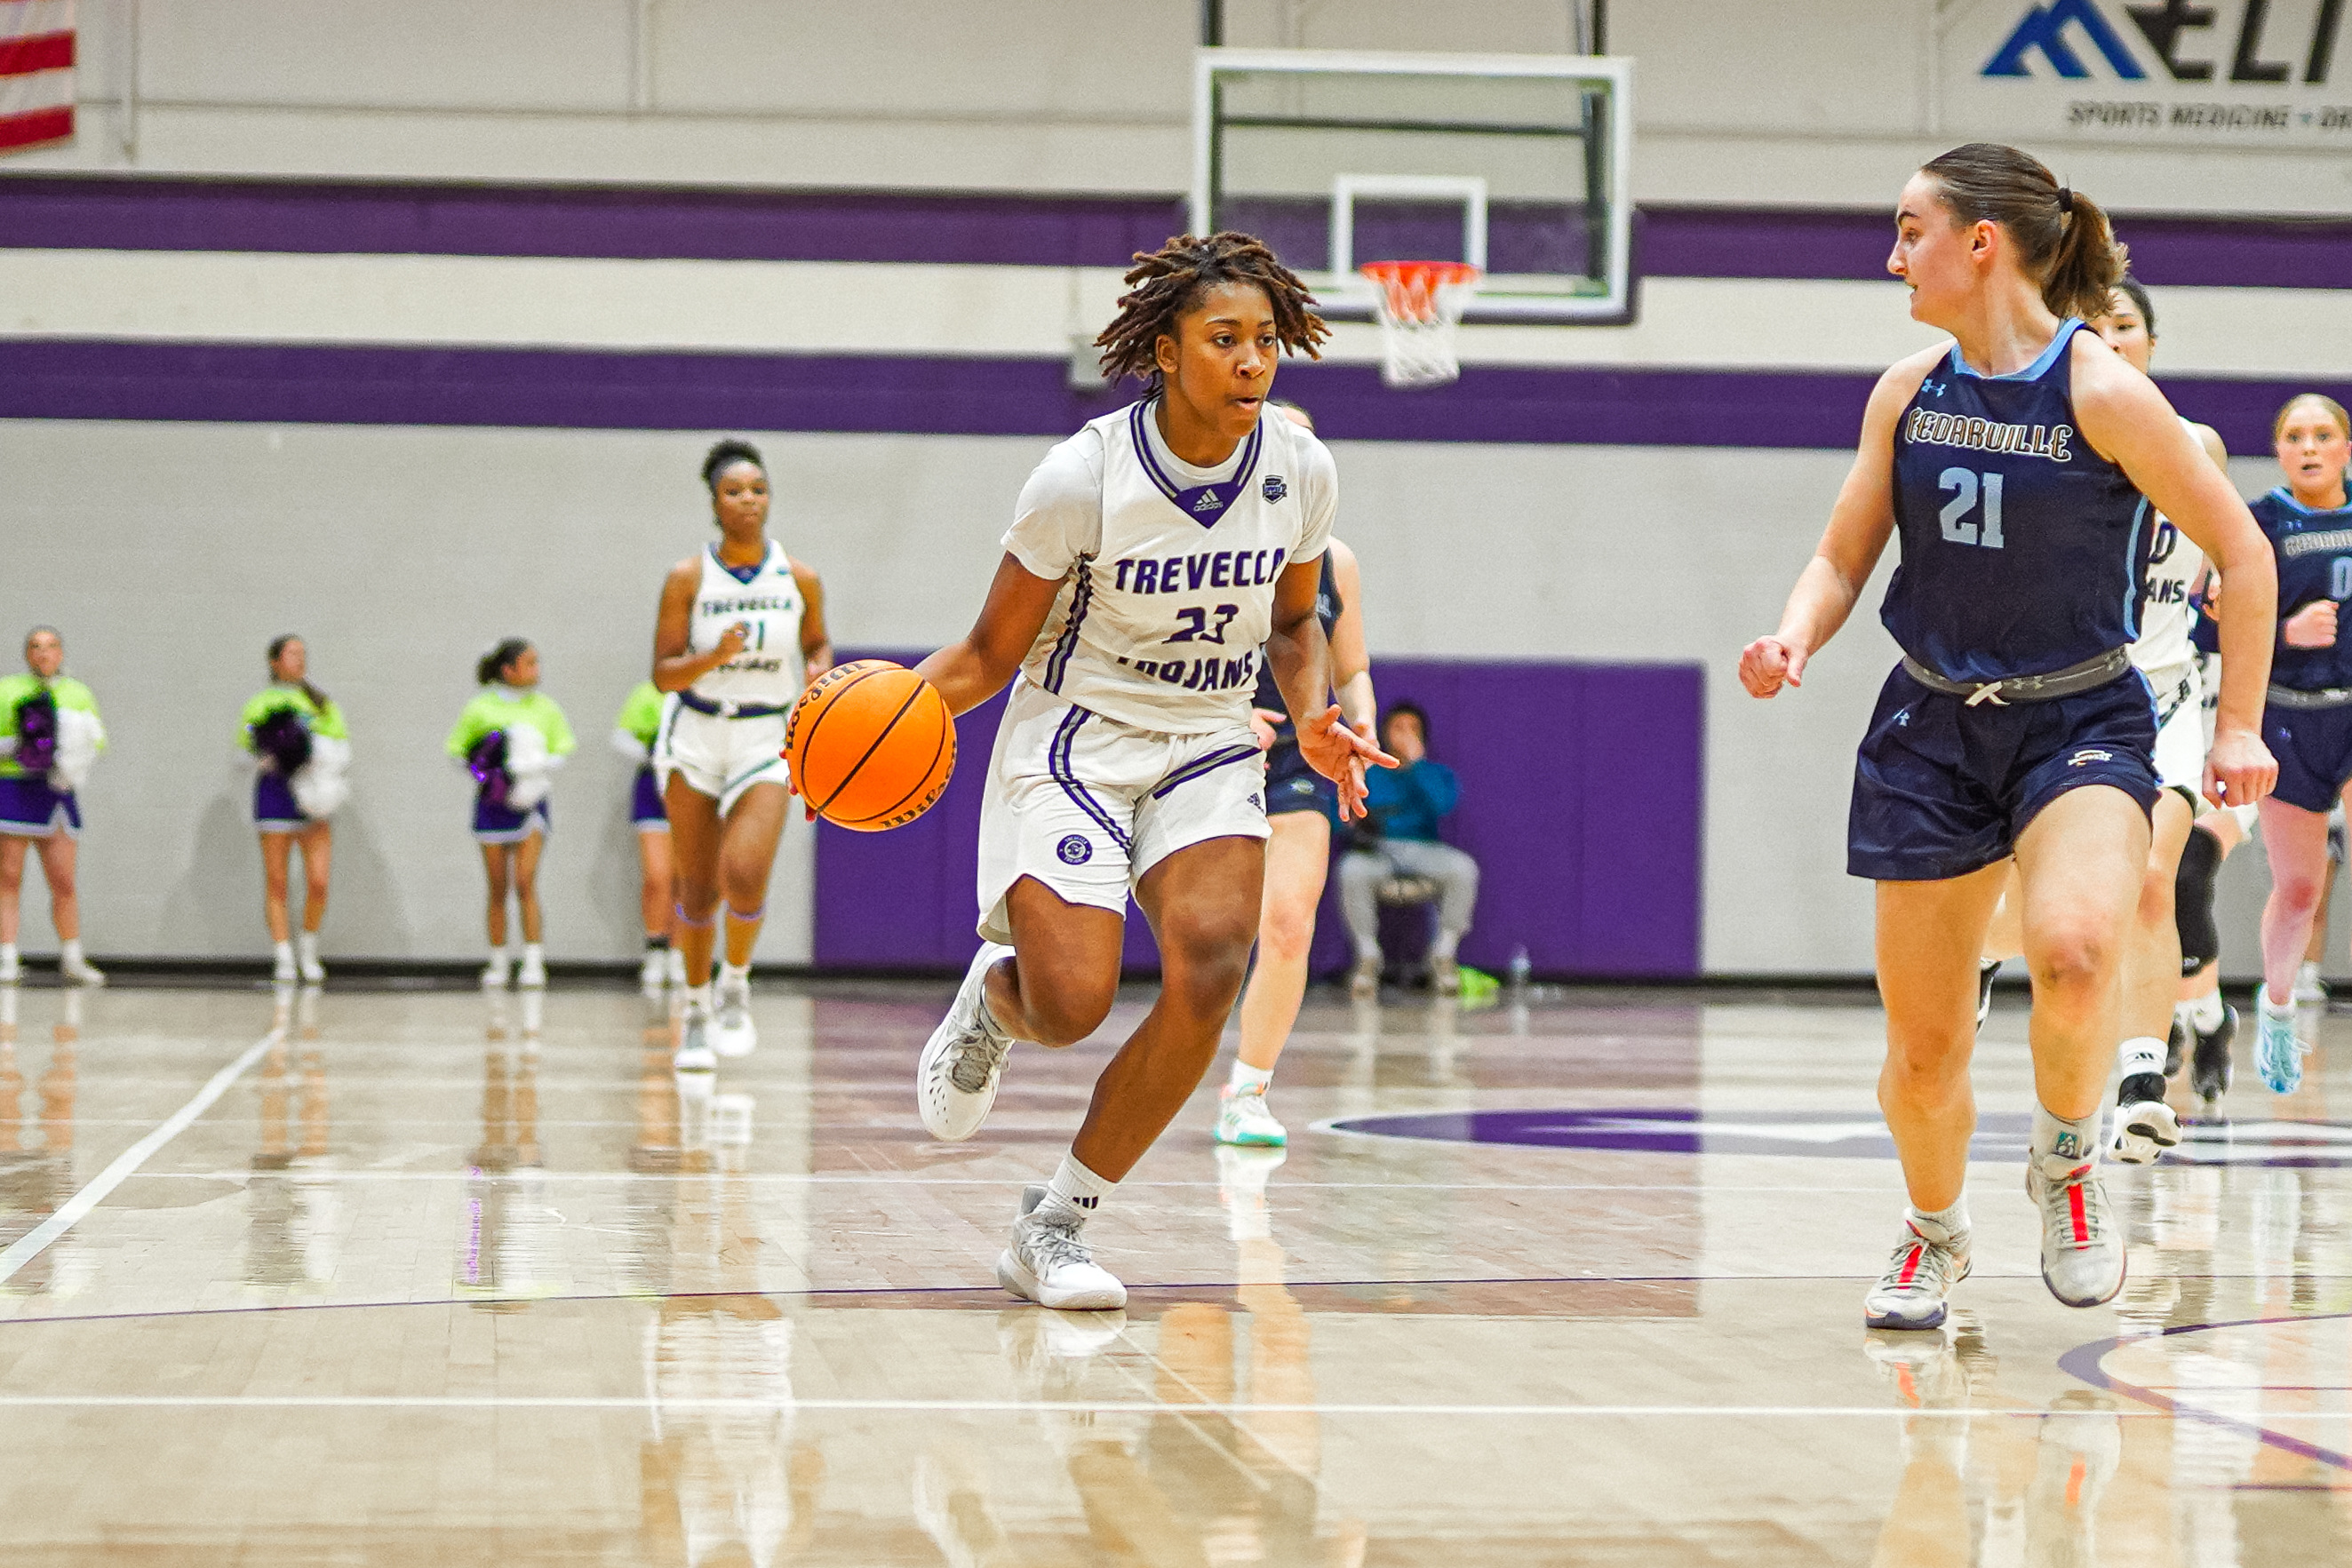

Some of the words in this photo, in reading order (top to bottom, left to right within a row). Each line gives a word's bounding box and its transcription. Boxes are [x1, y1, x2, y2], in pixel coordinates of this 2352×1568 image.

[2068, 99, 2162, 128] SPORTS
[2168, 101, 2292, 129] MEDICINE
[1938, 466, 2005, 549] 21
[1161, 602, 1240, 645] 23
[1116, 649, 1254, 693] OJANS
